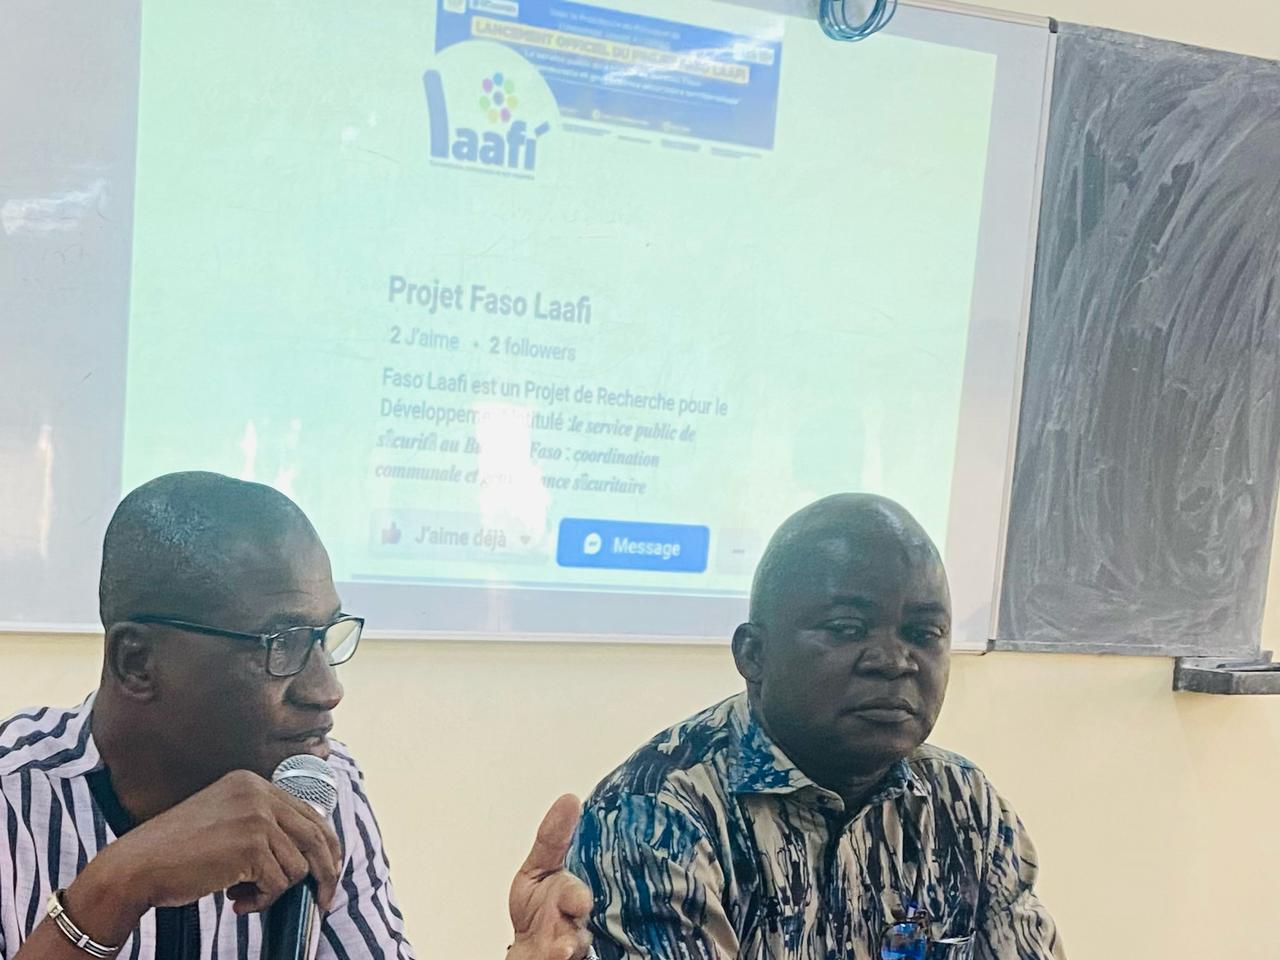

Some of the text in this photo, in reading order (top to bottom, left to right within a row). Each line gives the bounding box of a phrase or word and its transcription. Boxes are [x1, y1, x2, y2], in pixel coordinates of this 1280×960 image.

[388, 275, 592, 324] Projet Faso Laafi
[390, 325, 401, 344] 2
[489, 335, 501, 354] 2
[505, 336, 577, 362] followers
[382, 367, 728, 417] Faso Laafi est un Projet de Recherche pour le
[585, 418, 632, 437] service
[634, 422, 677, 442] public
[679, 424, 696, 442] de
[440, 437, 459, 453] au
[530, 441, 562, 461] Faso
[573, 447, 660, 468] coordination
[375, 463, 462, 484] communale
[415, 524, 507, 552] J'aime déjà
[613, 535, 681, 560] Message
